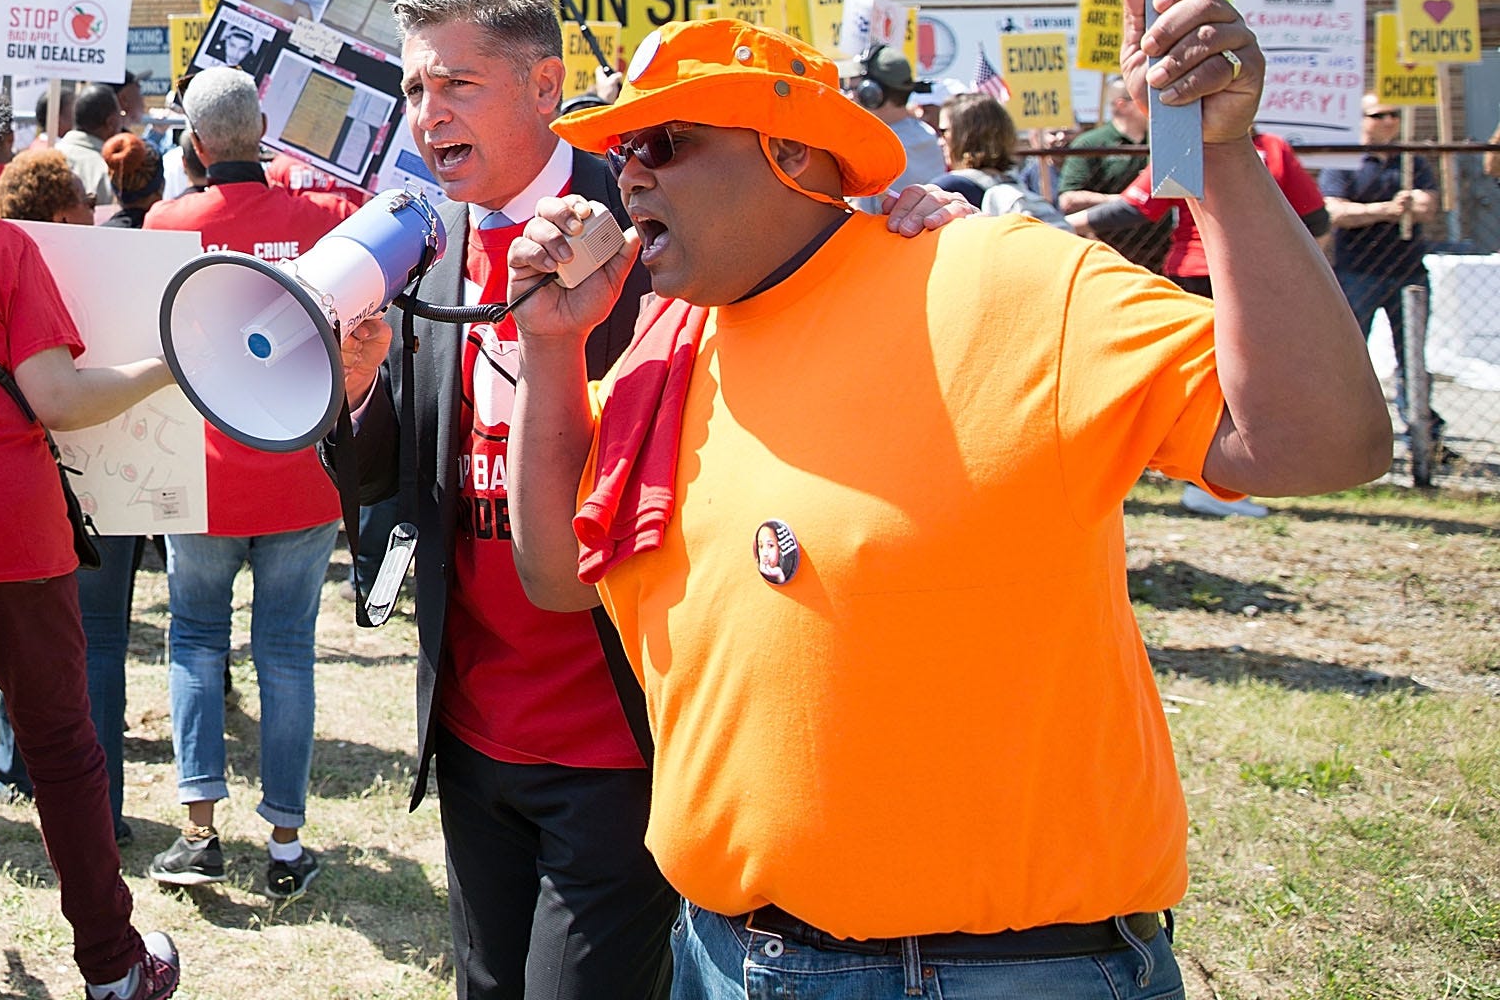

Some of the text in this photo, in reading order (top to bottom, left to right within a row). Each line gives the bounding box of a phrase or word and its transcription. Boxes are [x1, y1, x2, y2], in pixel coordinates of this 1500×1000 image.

[8, 7, 59, 29] STOP
[8, 30, 58, 44] BAD APPLE
[184, 21, 209, 41] DON
[1409, 30, 1473, 54] CHUCK'S
[7, 43, 106, 64] GUN DEALERS
[570, 34, 613, 56] EXUS
[1008, 46, 1064, 73] EXODUS
[1091, 51, 1121, 66] APPL
[1383, 76, 1438, 98] CHUCK'S
[1023, 90, 1059, 116] 20:16
[1263, 89, 1348, 119] ARRY!
[254, 241, 300, 259] CRIME
[473, 454, 508, 490] BA
